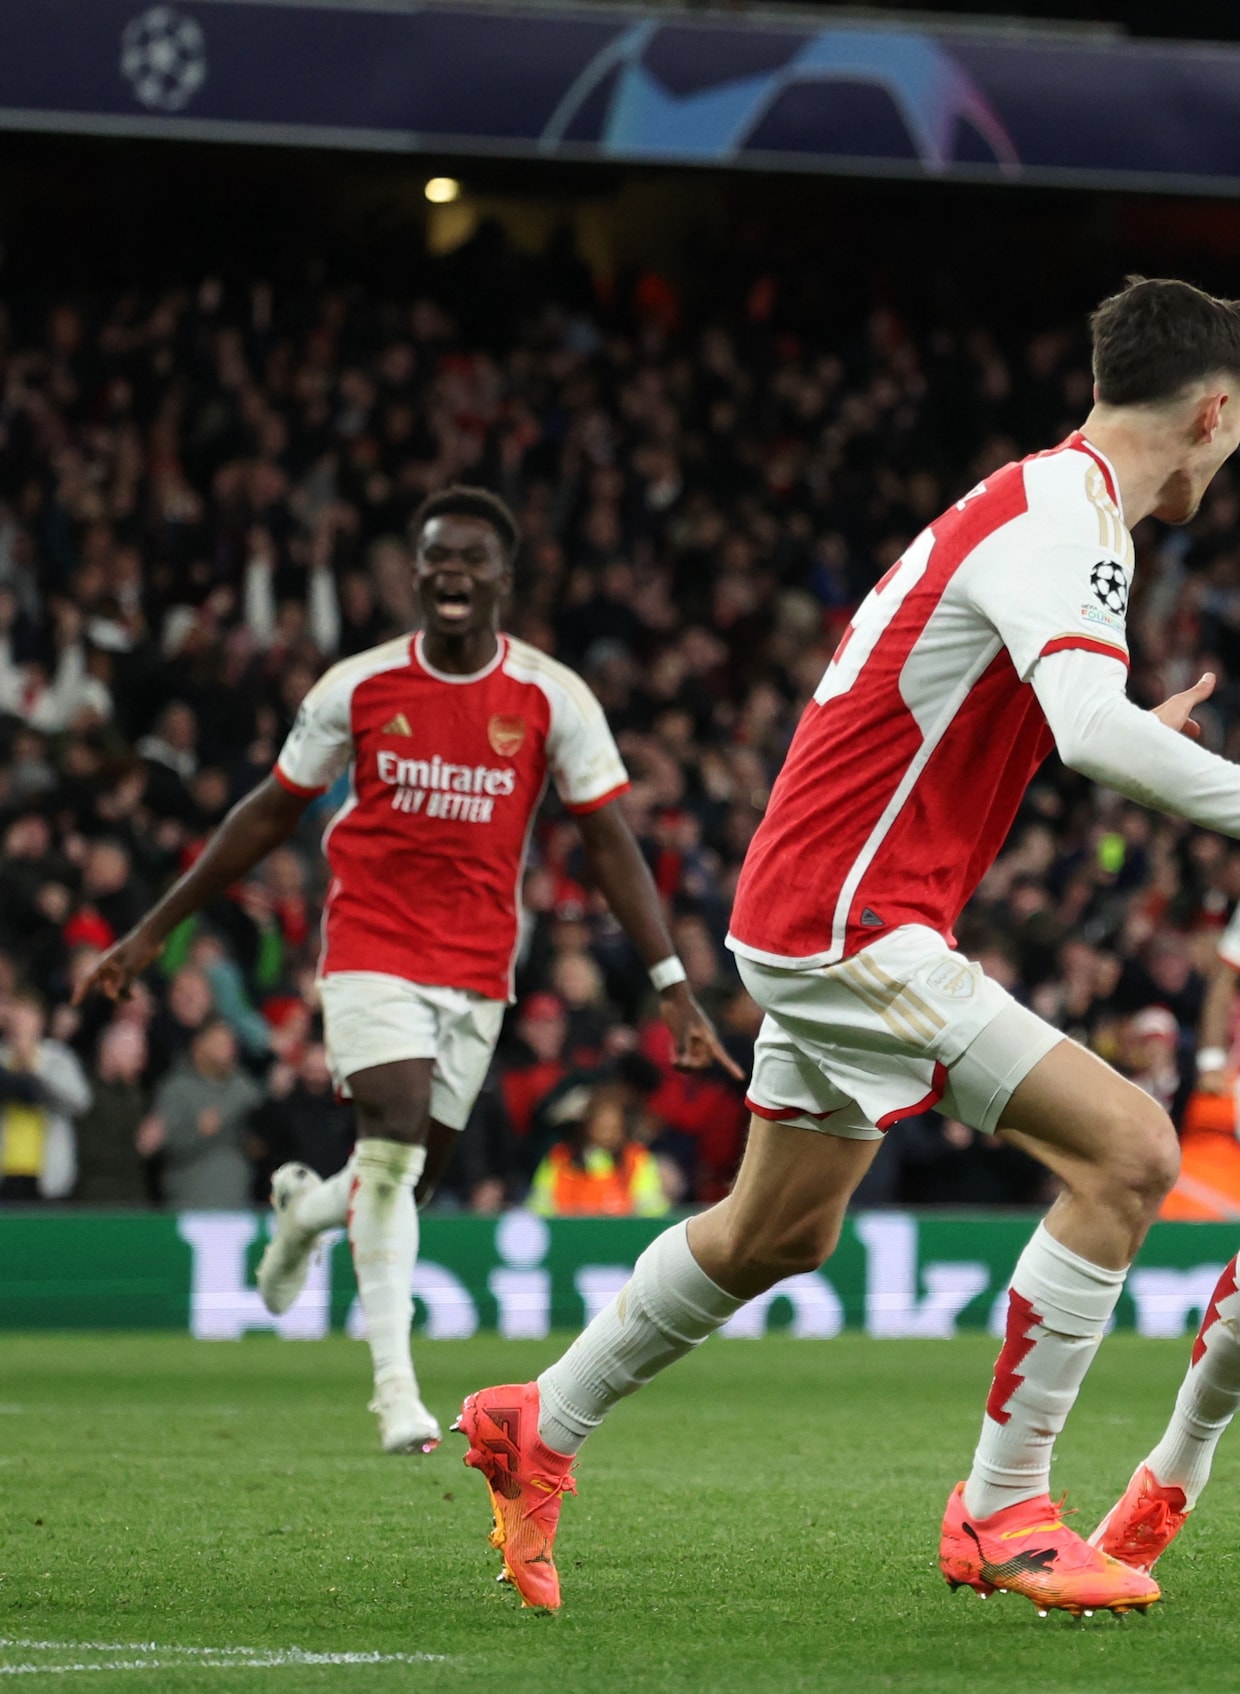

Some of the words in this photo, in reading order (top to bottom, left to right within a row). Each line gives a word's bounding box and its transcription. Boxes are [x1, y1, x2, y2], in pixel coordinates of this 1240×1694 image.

[376, 750, 516, 796] Emirates
[391, 786, 426, 814] FLY
[426, 790, 495, 824] BETTER
